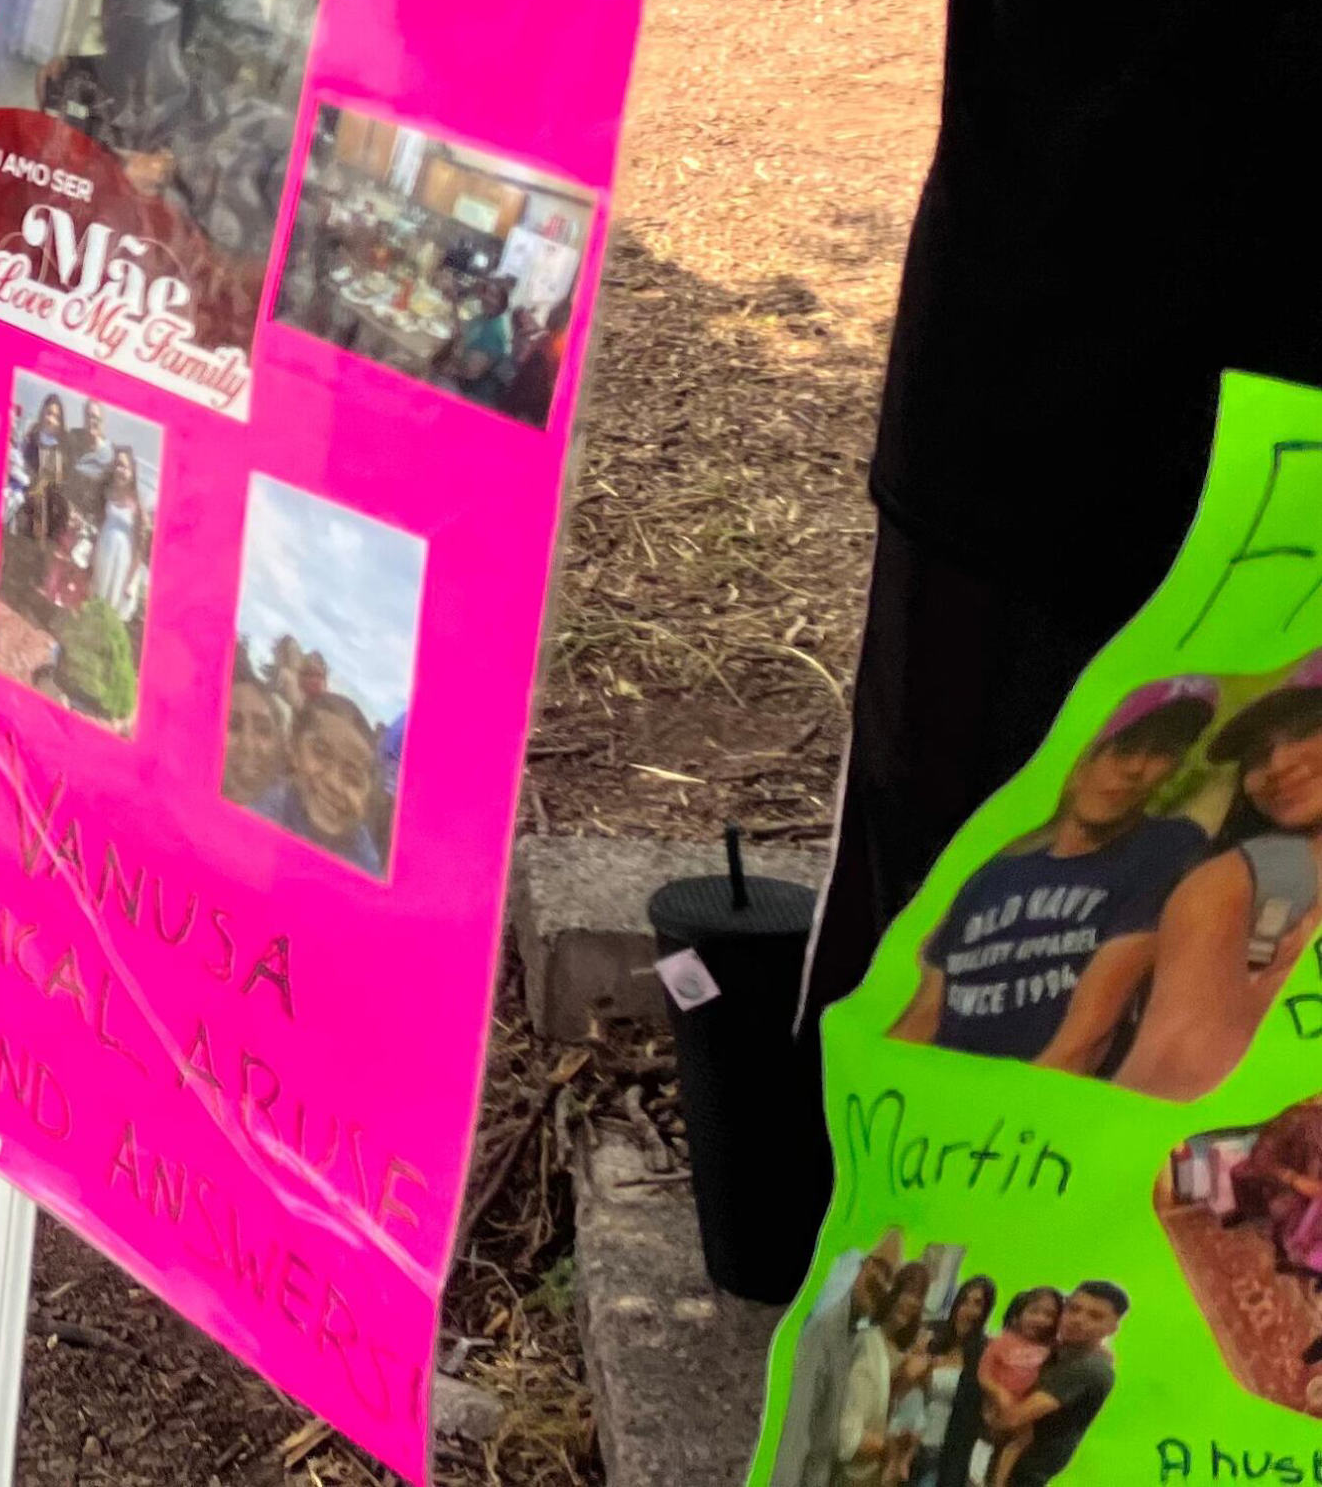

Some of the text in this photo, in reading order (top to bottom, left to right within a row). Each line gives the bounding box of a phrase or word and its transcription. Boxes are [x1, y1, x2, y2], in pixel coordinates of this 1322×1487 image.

[1, 152, 52, 187] AMO
[50, 168, 95, 203] SER
[21, 203, 191, 319] Mãe
[59, 295, 131, 360] My
[132, 313, 248, 408] Family
[6, 729, 295, 1018] VANUSA
[963, 886, 1108, 944] OLD NAVY
[1015, 927, 1098, 960] APPAREL
[947, 981, 1009, 1016] SINCE
[177, 1017, 429, 1231] ABUSE
[844, 1088, 1073, 1225] Martin
[1157, 1436, 1192, 1483] A
